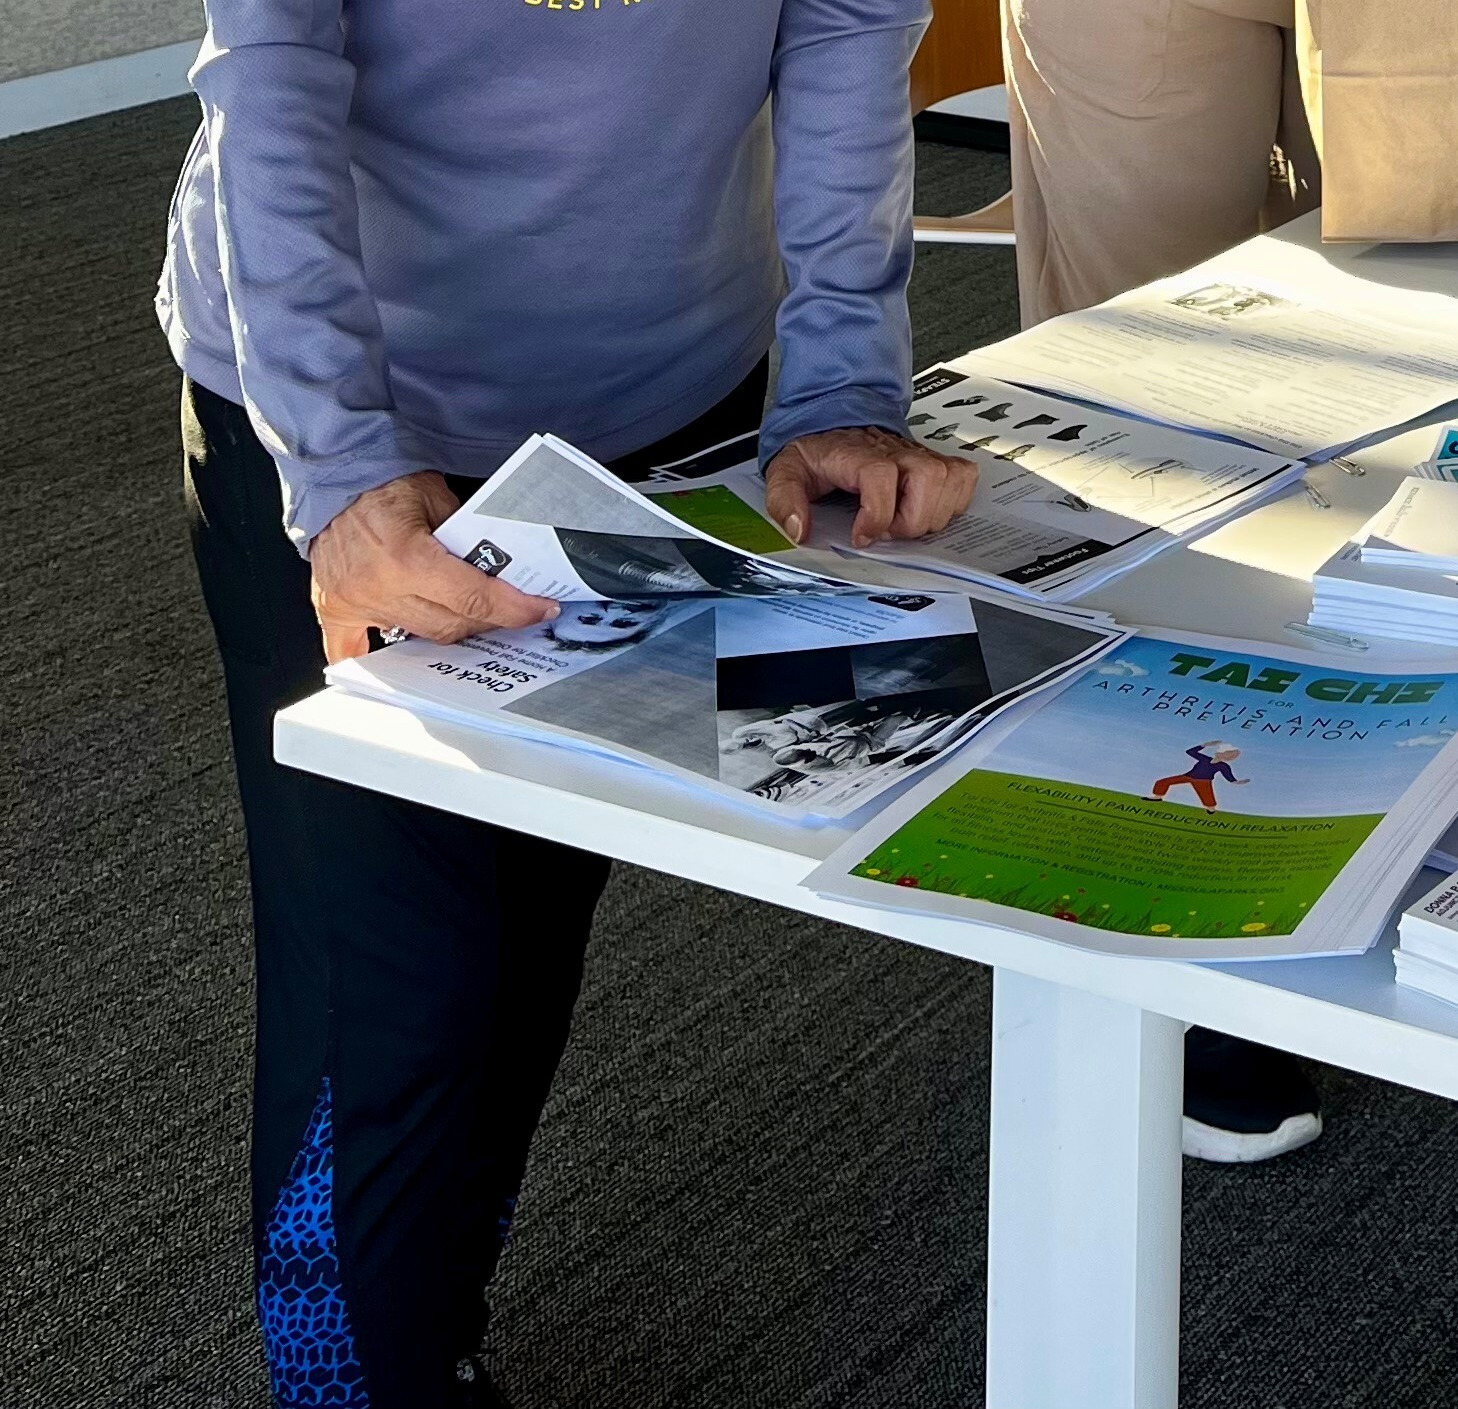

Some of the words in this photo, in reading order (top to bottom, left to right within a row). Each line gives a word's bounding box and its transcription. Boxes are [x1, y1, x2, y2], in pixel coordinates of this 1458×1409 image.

[1044, 548, 1089, 567] Footwear
[1021, 566, 1045, 575] Tips
[428, 661, 457, 676] for
[477, 660, 538, 683] Safety
[527, 654, 569, 668] Checklist
[457, 670, 514, 693] Check
[1170, 652, 1301, 694] TAI
[1304, 678, 1447, 705] CHI
[1093, 680, 1265, 720] ARTHRITIS
[1287, 714, 1356, 730] AND
[1377, 715, 1448, 730] FALL
[1267, 699, 1294, 710] FOR
[1152, 701, 1369, 741] PREVENTION
[1007, 781, 1096, 805] FLEXABILITY
[1105, 799, 1144, 815] PAIN
[1144, 808, 1230, 829] REDUCTION
[1241, 821, 1335, 833] RELAXATION
[1421, 889, 1455, 913] DONNA
